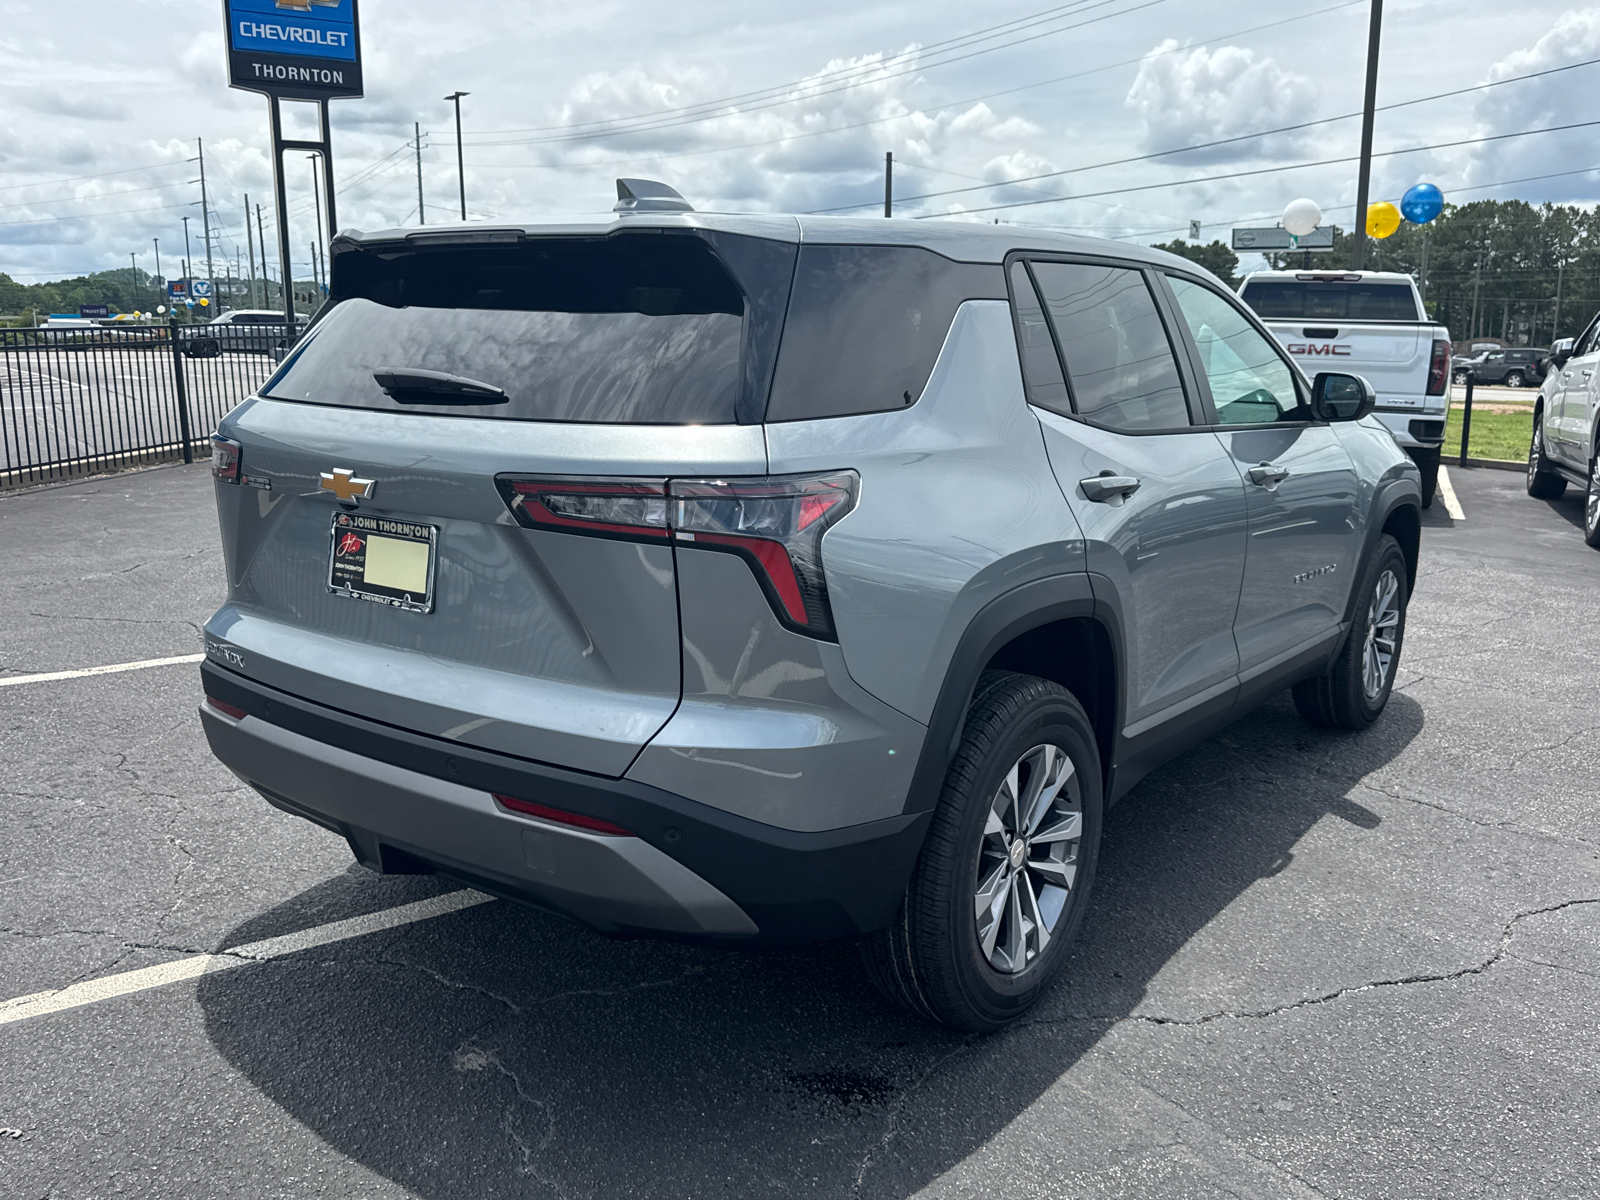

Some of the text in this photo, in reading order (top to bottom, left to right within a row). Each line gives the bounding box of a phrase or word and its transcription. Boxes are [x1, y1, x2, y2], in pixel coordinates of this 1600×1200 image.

[239, 21, 348, 47] CHEVROLET
[252, 63, 344, 85] THORNTON
[1287, 344, 1351, 355] GMC
[354, 517, 428, 537] JOHN THORNTON
[345, 564, 363, 572] THORNTON
[361, 594, 390, 604] CHEVROLET
